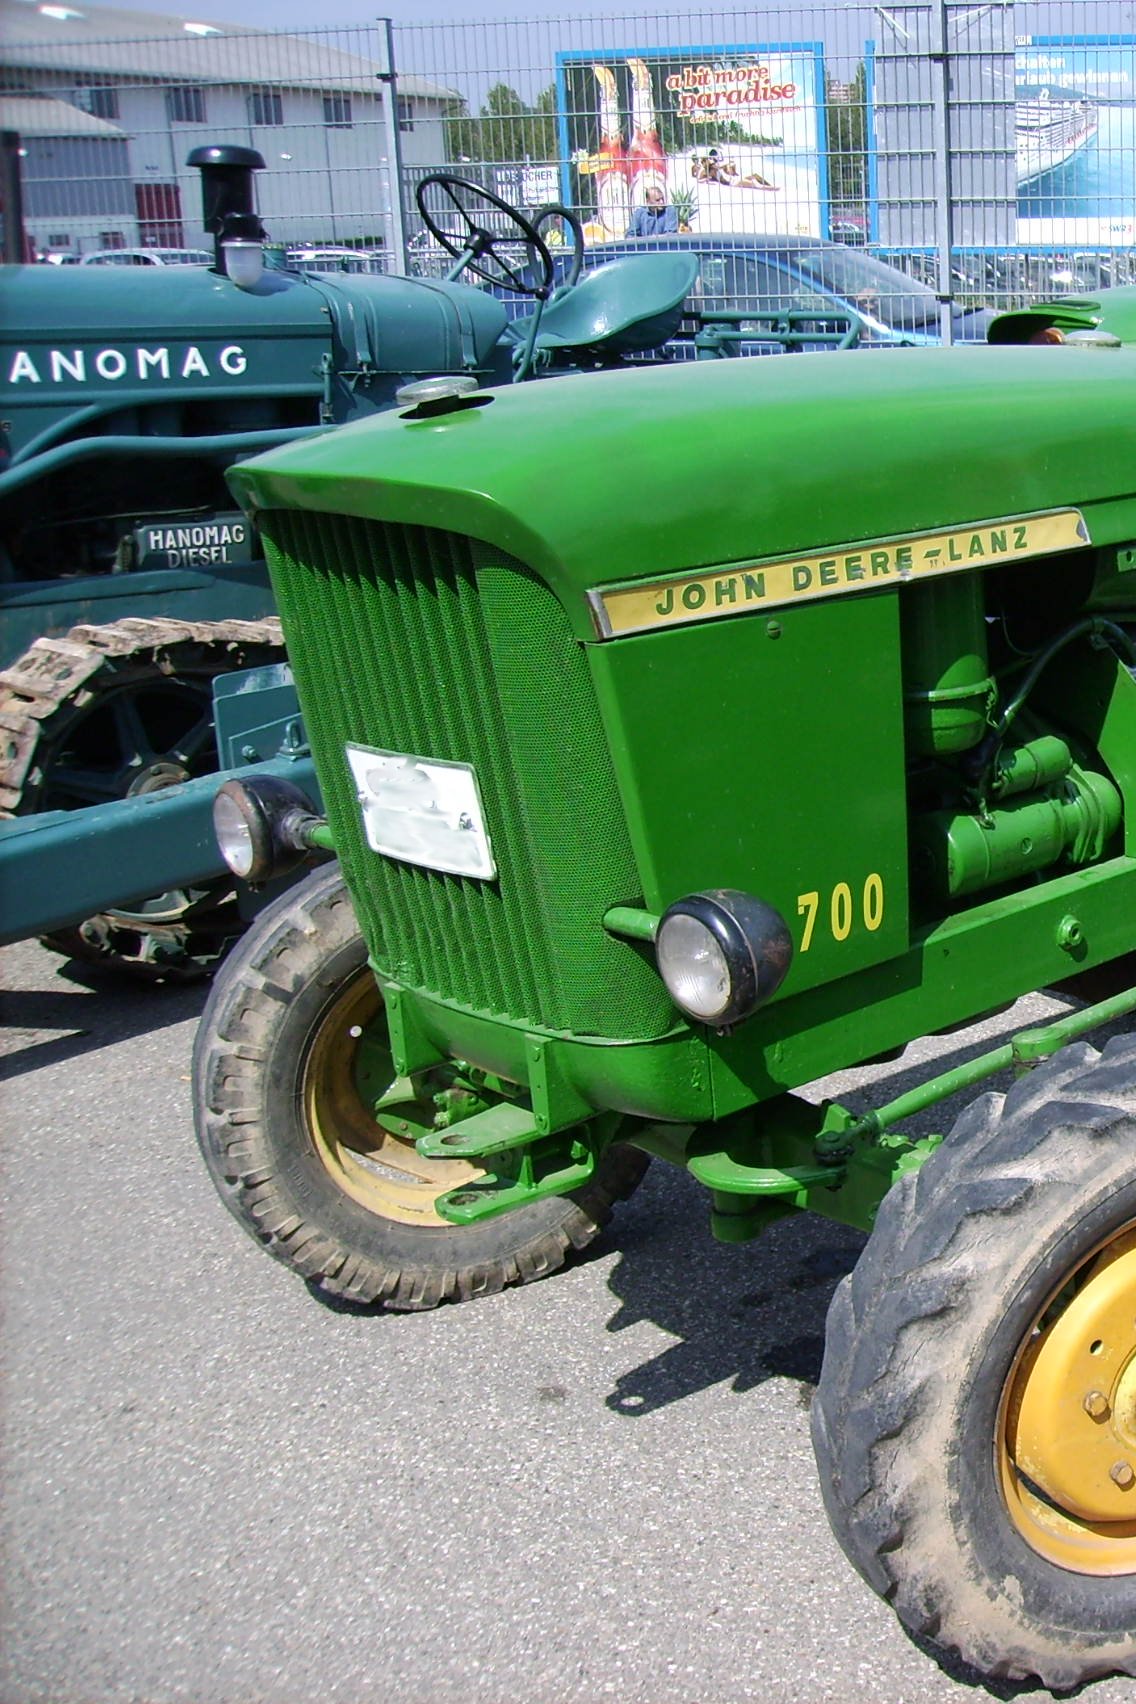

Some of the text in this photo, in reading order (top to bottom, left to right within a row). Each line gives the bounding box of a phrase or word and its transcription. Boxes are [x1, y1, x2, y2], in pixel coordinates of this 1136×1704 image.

[667, 67, 768, 88] a bit more
[678, 78, 797, 115] paradise
[150, 525, 245, 550] HANOMAG
[167, 546, 233, 569] DIESEL
[655, 572, 767, 616] JOHN
[797, 873, 884, 953] 700
